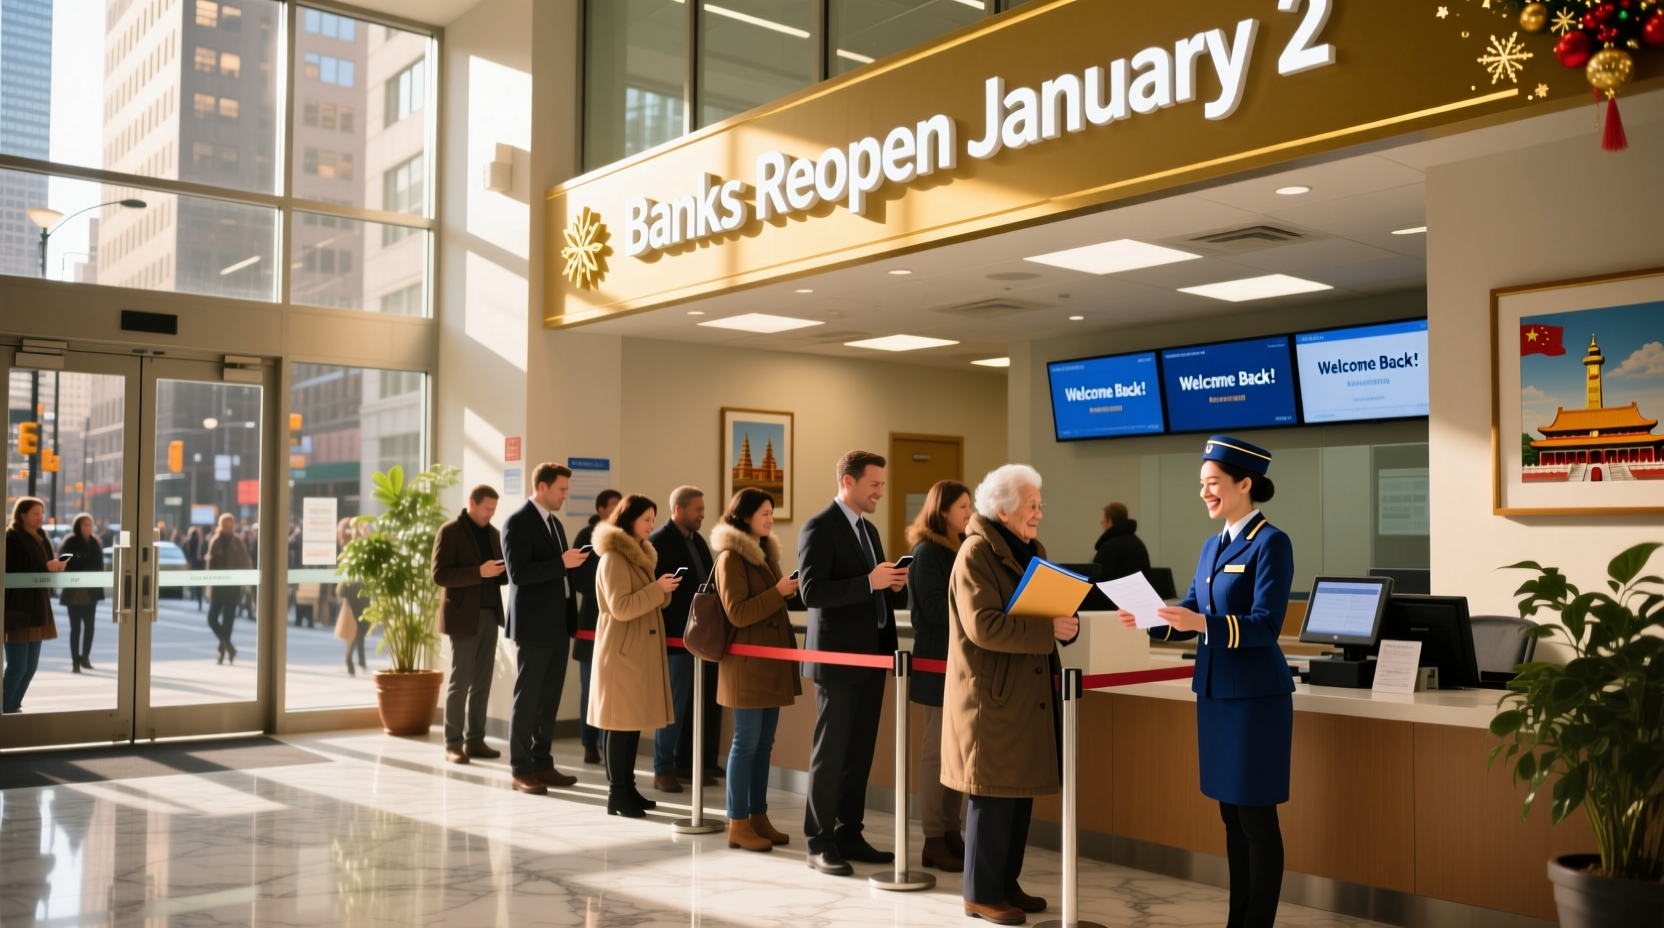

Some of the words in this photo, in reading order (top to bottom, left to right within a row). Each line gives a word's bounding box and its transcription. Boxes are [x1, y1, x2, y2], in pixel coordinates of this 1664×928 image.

[625, 173, 748, 258] Banks
[755, 114, 957, 220] Reopen
[968, 18, 1260, 159] January
[1277, 0, 1336, 76] 2
[1317, 359, 1376, 375] Welcome
[1379, 352, 1419, 370] Back!
[1179, 374, 1235, 391] Welcome
[1238, 368, 1276, 386] Back!
